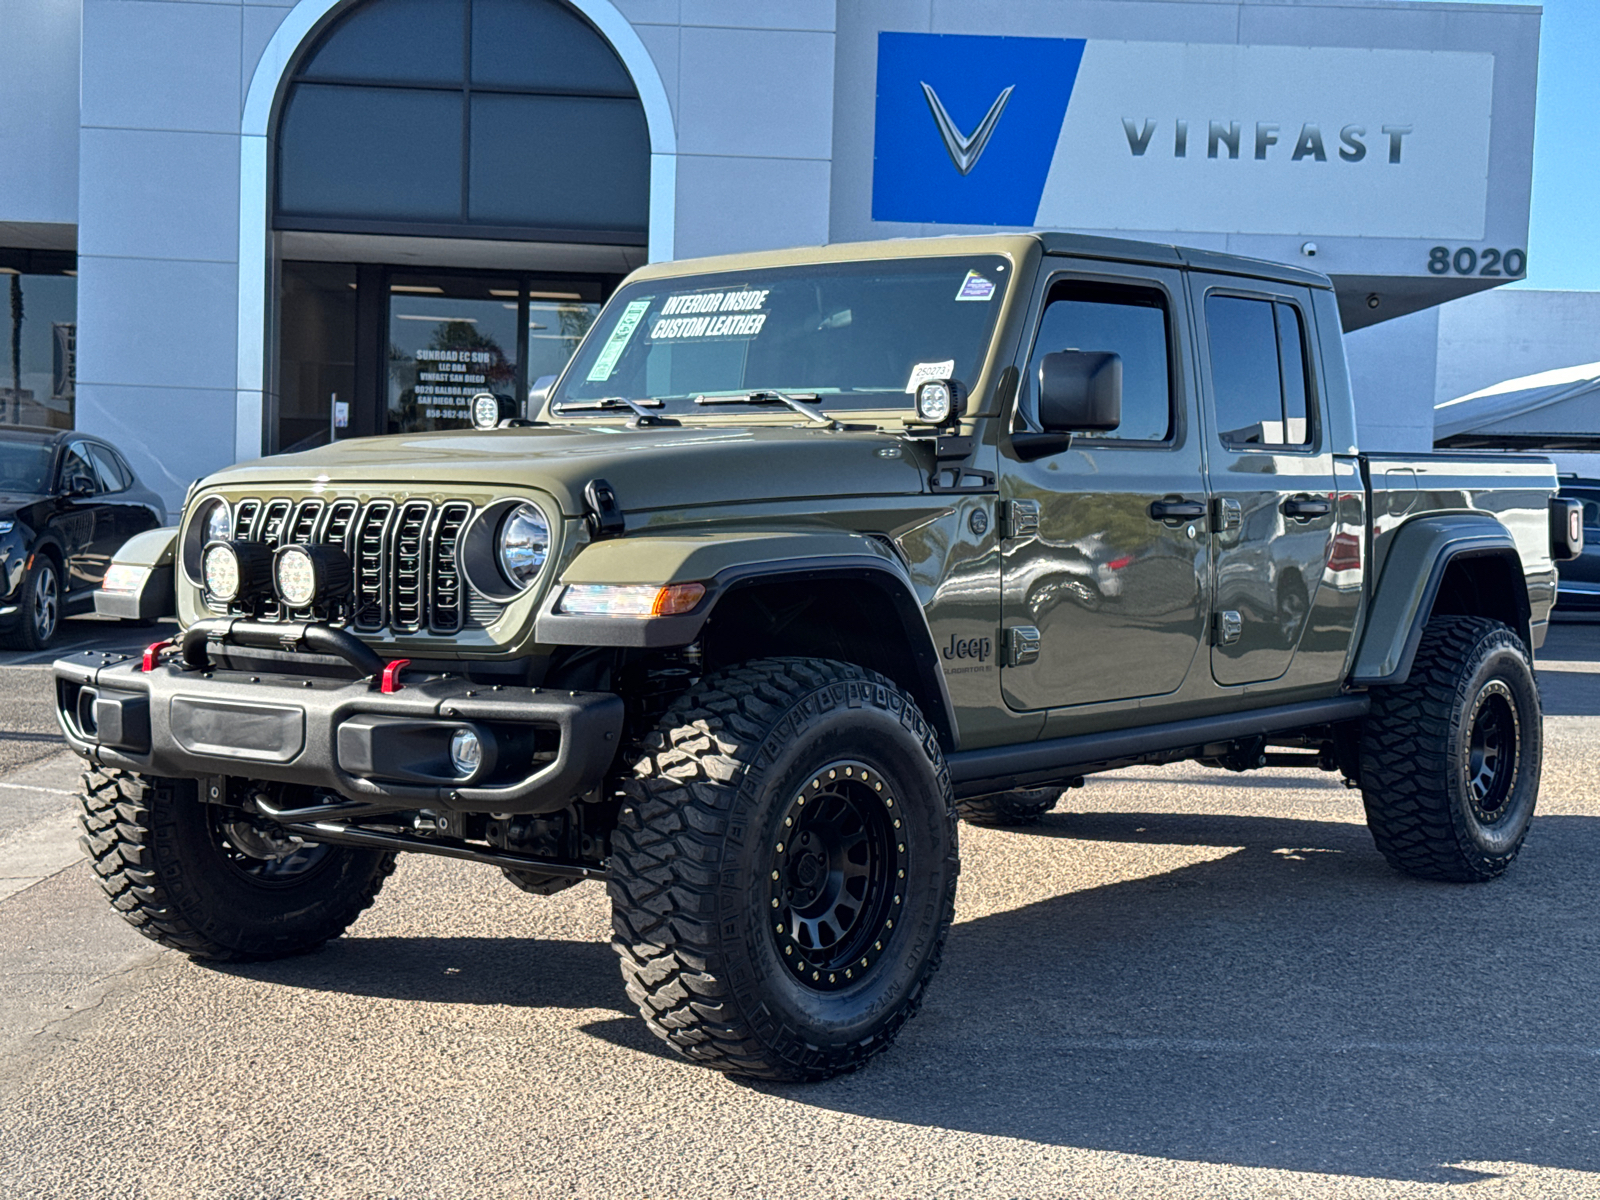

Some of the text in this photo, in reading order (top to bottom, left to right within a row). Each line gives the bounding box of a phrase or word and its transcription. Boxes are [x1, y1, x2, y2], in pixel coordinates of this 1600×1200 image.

[1121, 117, 1413, 164] VINFAST
[1427, 246, 1527, 277] 8020
[661, 289, 770, 316] INTERIOR INSIDE
[650, 313, 767, 339] CUSTOM LEATHER
[416, 349, 490, 363] SUNROAD EC SUB
[414, 385, 434, 394] 8020
[434, 386, 462, 395] BALBOA
[420, 372, 486, 384] VINFAST SAN DIEGO
[417, 396, 432, 405] SAN
[455, 397, 466, 406] CA
[943, 633, 992, 662] Jeep
[903, 869, 940, 974] LEGEND
